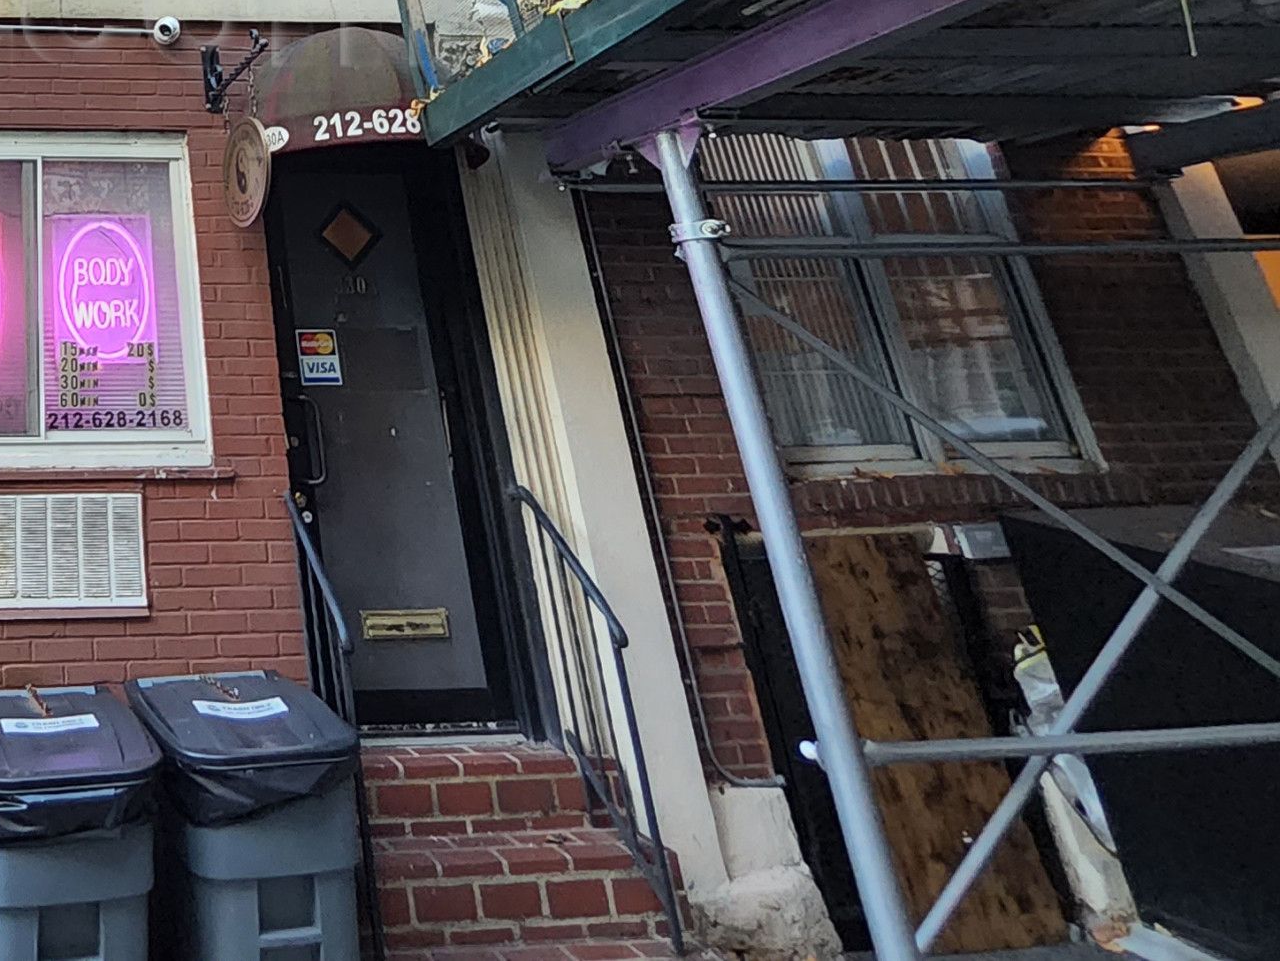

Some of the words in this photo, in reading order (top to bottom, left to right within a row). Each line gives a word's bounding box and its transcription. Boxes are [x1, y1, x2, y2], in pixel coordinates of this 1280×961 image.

[73, 257, 134, 287] BODY
[71, 298, 140, 329] WORK
[305, 361, 336, 374] VISA
[48, 409, 184, 430] 212-628-2168
